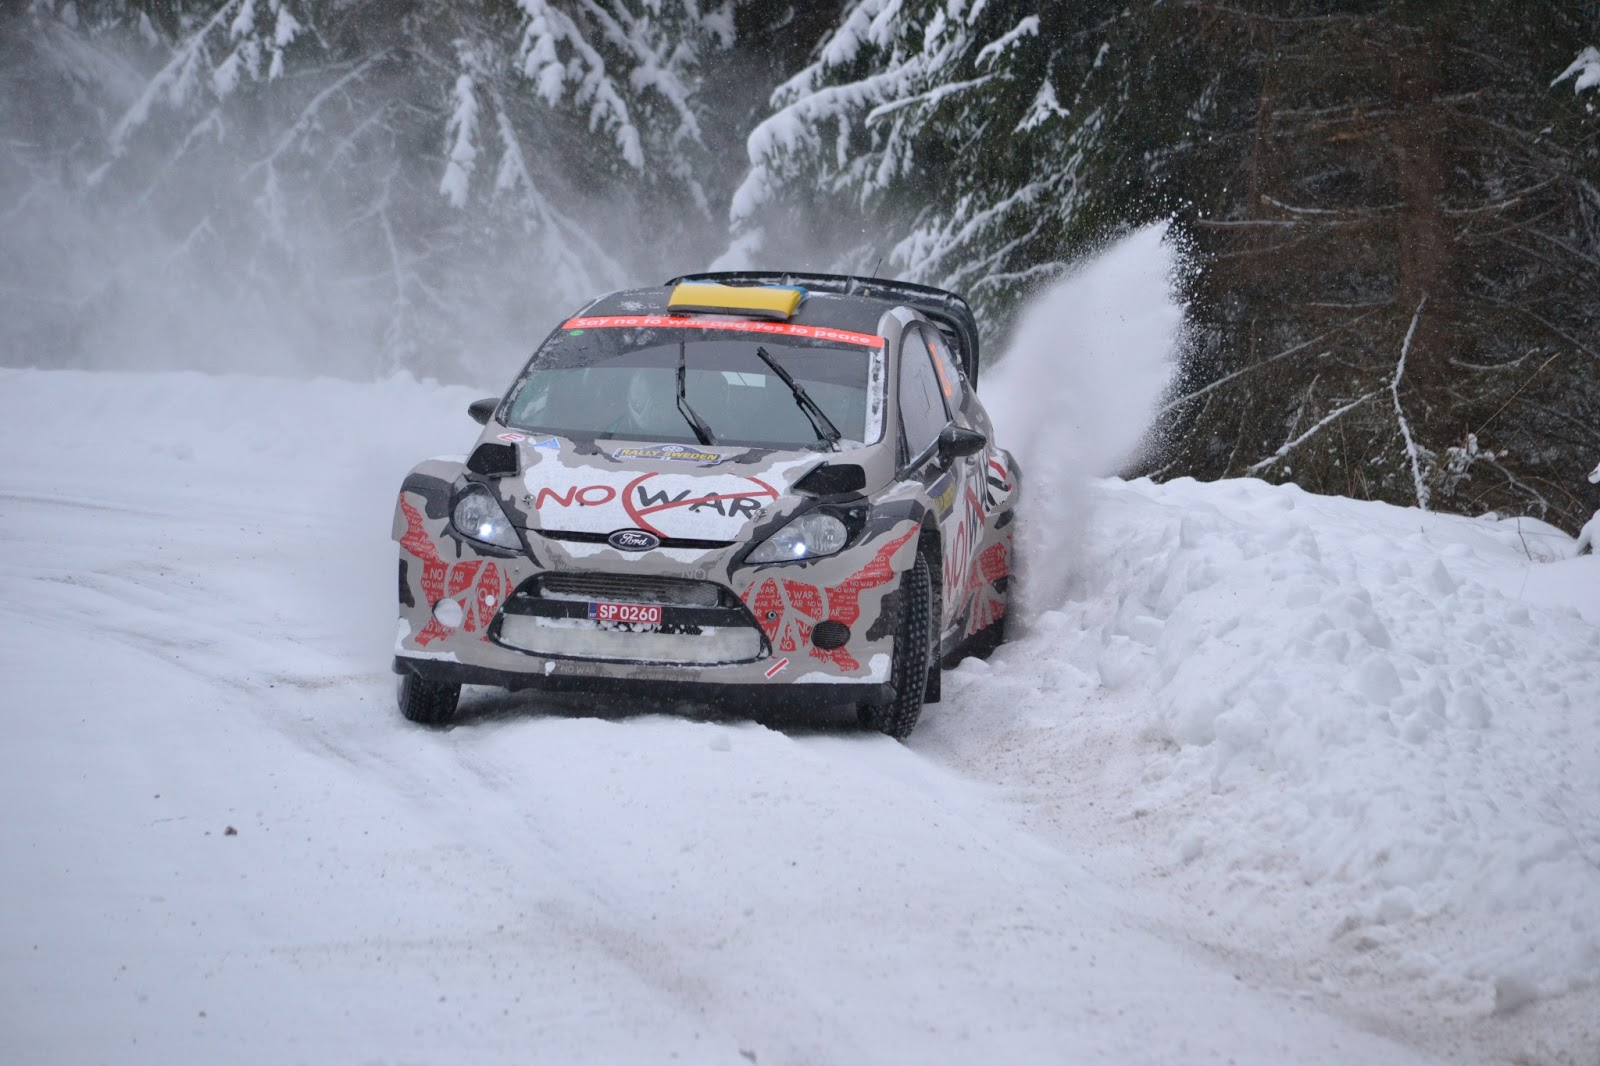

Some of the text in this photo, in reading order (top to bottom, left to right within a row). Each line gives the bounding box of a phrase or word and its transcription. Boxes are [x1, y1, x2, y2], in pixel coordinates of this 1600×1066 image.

[576, 319, 608, 327] Say
[790, 325, 808, 334] to
[814, 330, 871, 344] peace
[663, 451, 718, 461] SWEDEN
[535, 485, 763, 521] NO WAR
[619, 533, 648, 546] Ford
[430, 568, 444, 579] NO
[794, 591, 814, 599] WAR
[600, 604, 658, 622] SP 0260
[780, 641, 792, 649] NO
[561, 665, 596, 675] NO WAR
